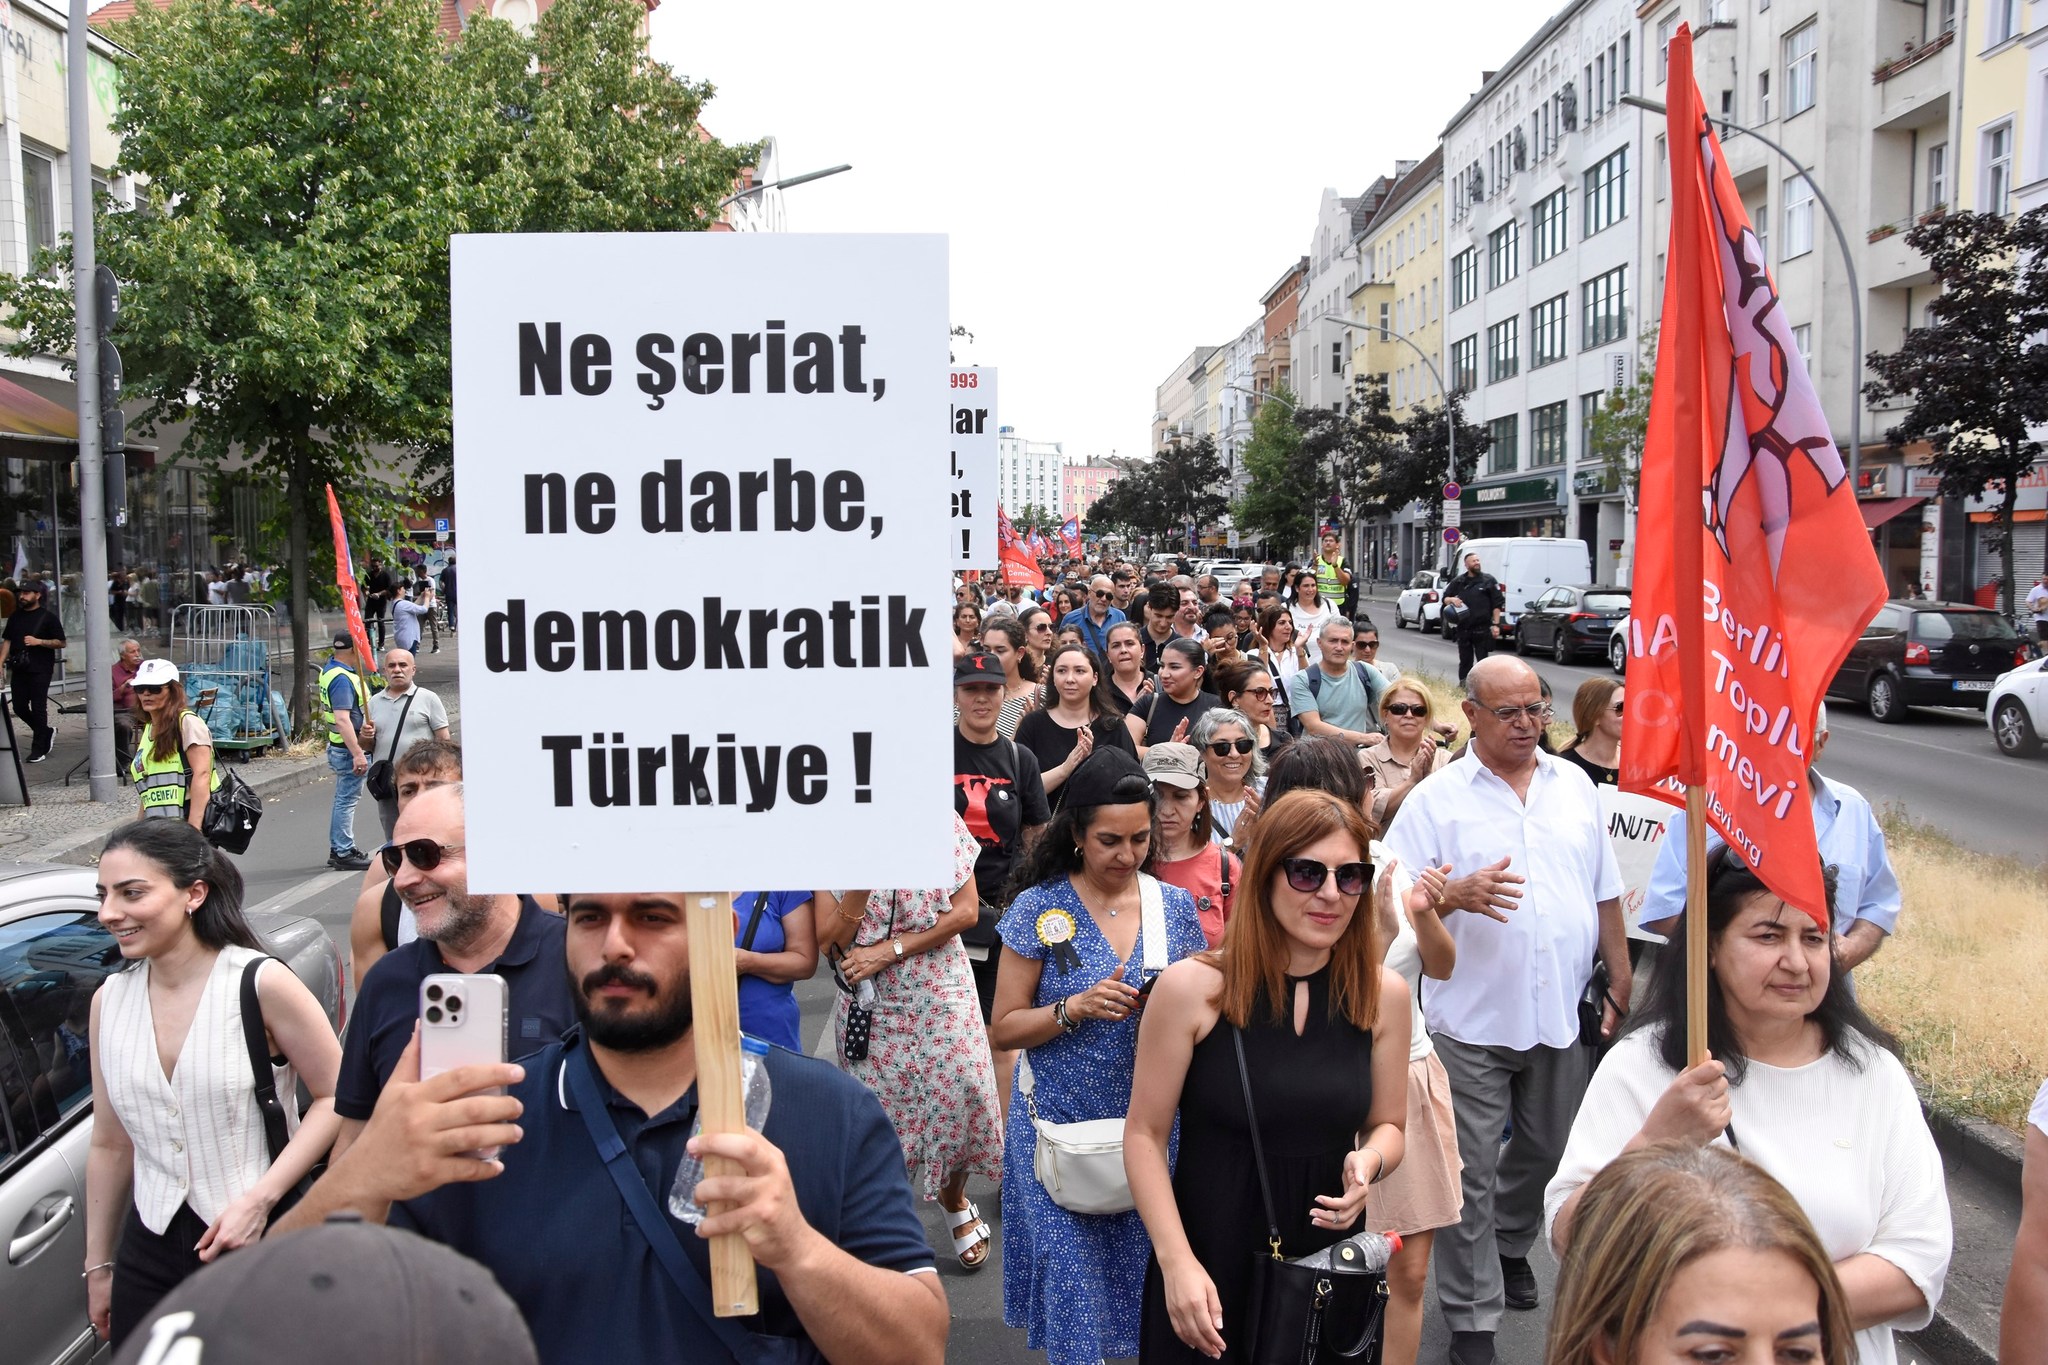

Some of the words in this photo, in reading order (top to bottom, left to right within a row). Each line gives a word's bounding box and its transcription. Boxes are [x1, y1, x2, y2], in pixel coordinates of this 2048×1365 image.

[518, 322, 612, 396] Ne
[636, 320, 886, 411] şeriat,
[524, 472, 616, 535] ne
[640, 458, 883, 540] darbe,
[484, 595, 929, 673] demokratik
[541, 731, 828, 813] Türkiye
[852, 731, 872, 804] !
[1706, 792, 1762, 868] levi.org
